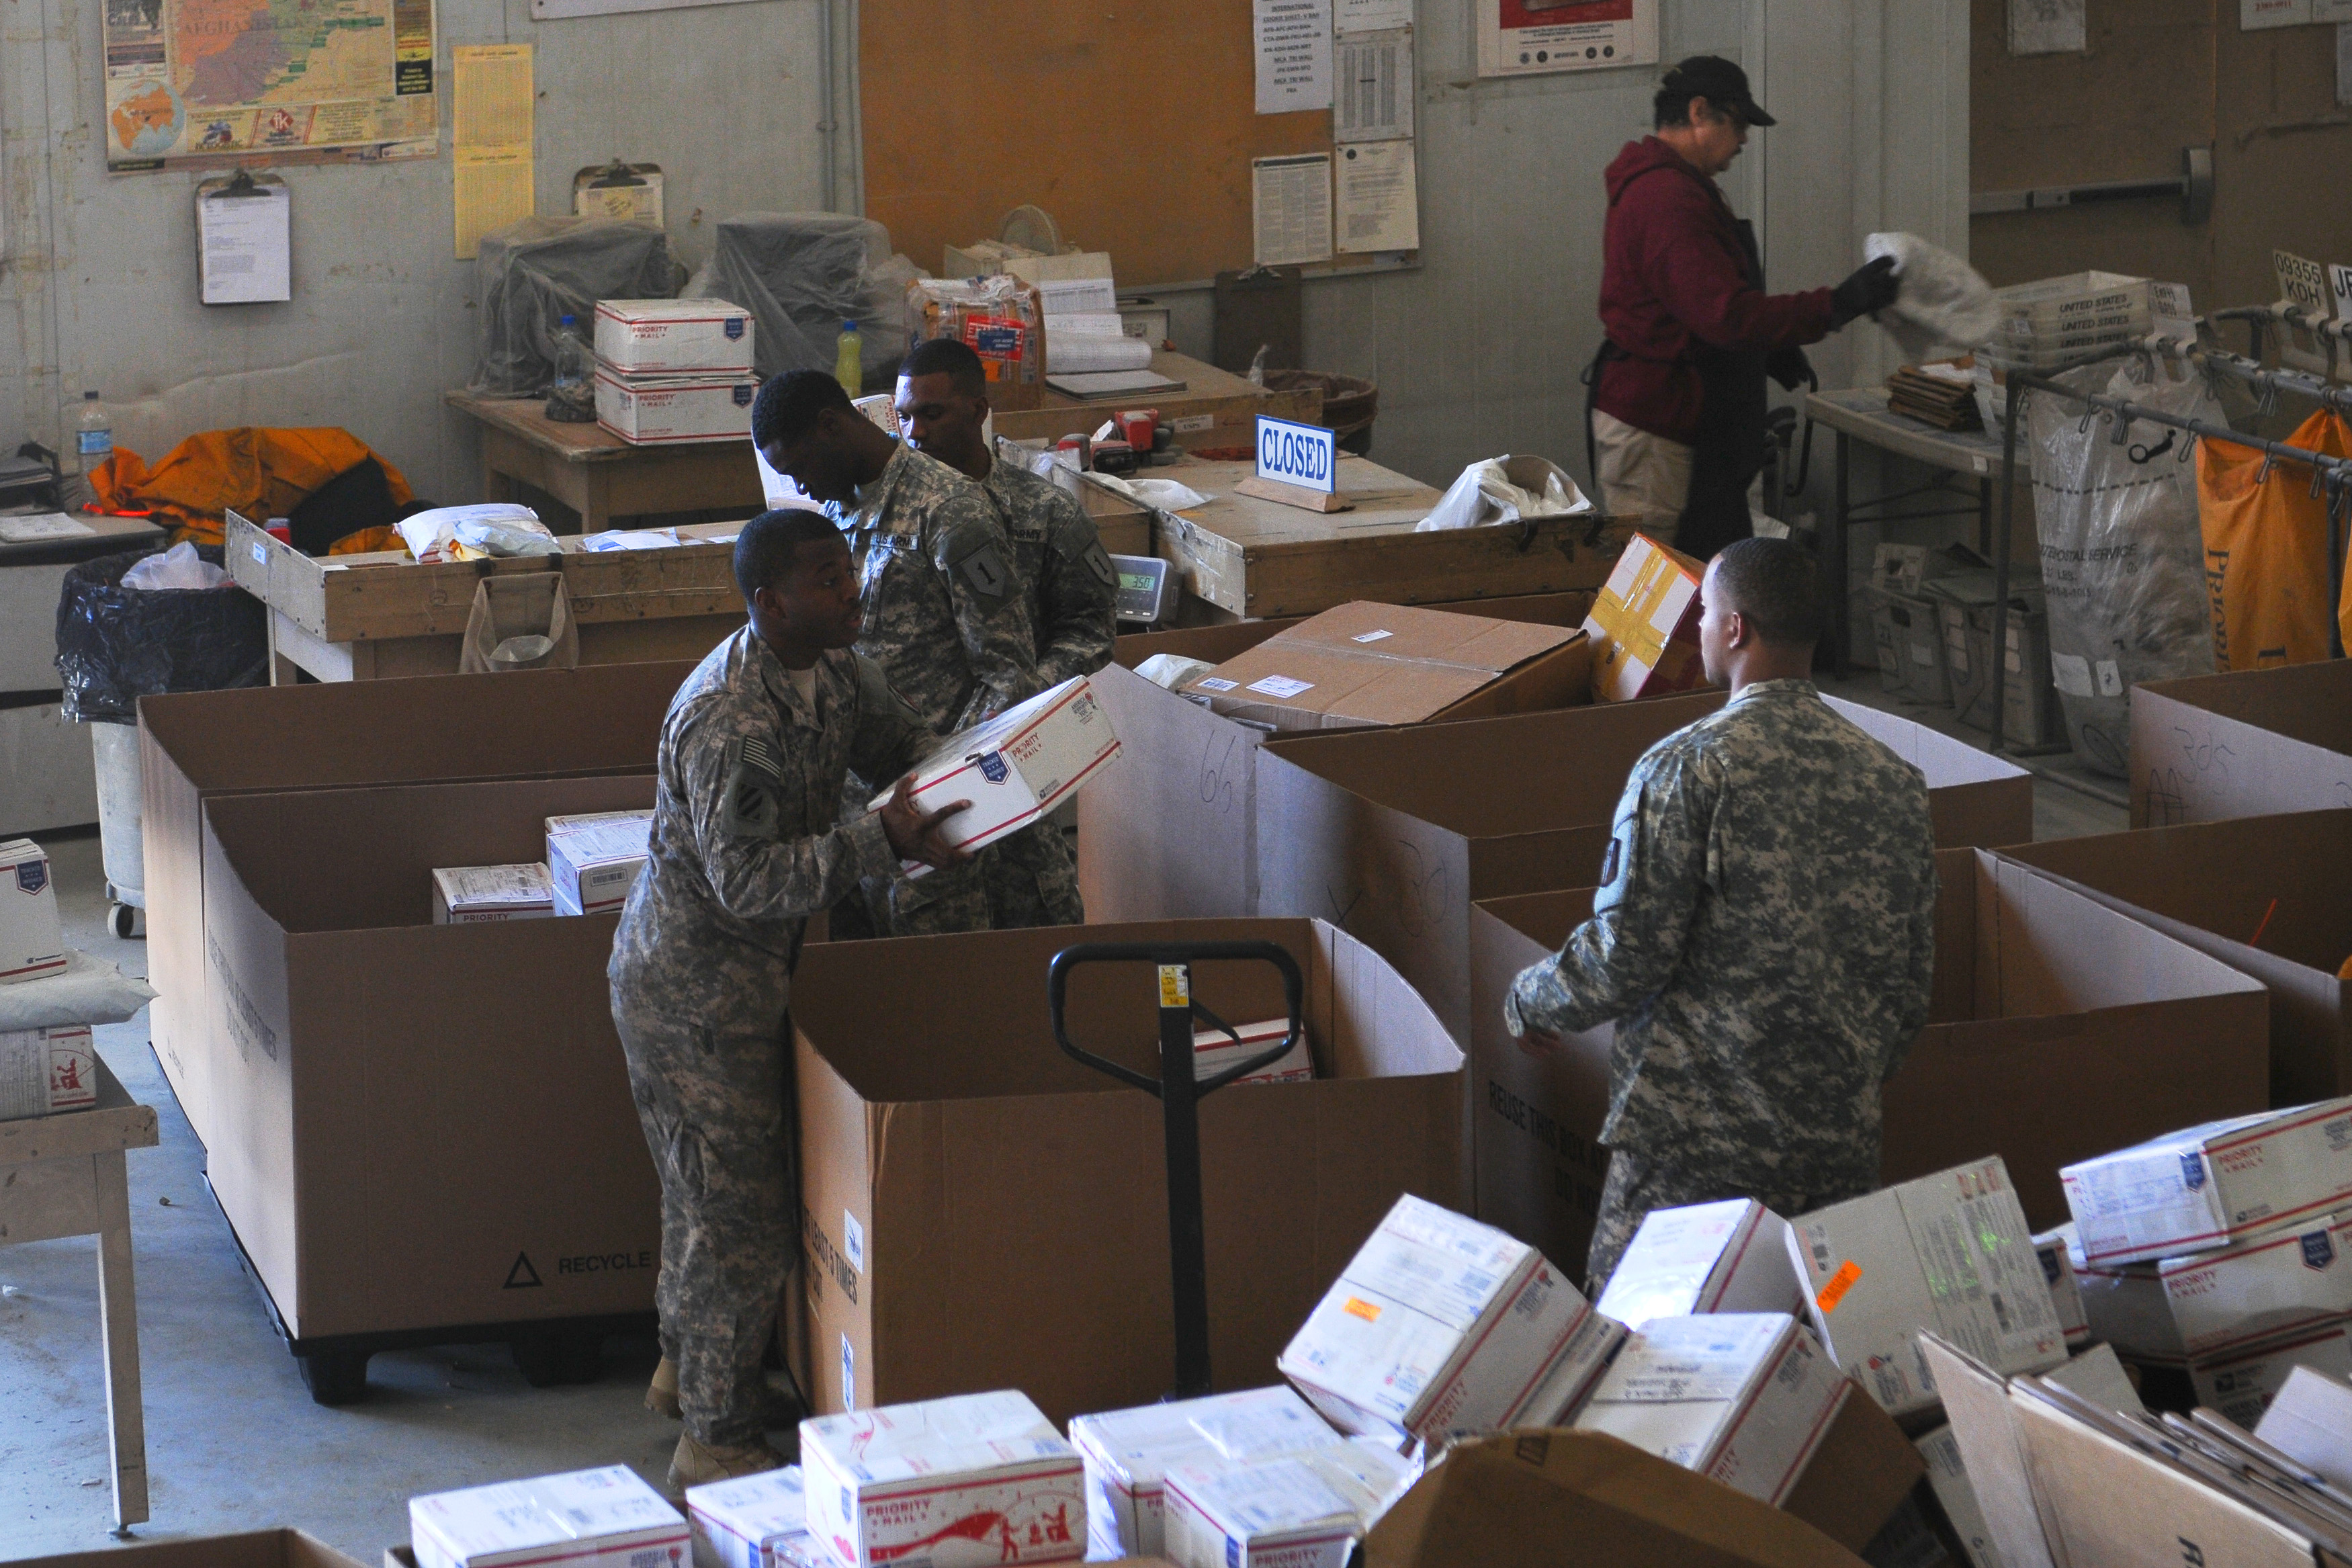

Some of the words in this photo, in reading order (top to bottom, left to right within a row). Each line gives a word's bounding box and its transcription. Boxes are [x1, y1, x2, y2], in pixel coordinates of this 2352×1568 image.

[2275, 253, 2321, 284] 09355
[2285, 277, 2321, 307] KDH
[2060, 300, 2093, 312] UNITED
[2095, 294, 2127, 306] STATES
[2062, 319, 2095, 331] UNITED
[2097, 314, 2129, 327] STATES
[887, 402, 898, 432] PRIORI
[1263, 427, 1327, 480] CLOSED
[2089, 543, 2137, 560] SERVICE
[1012, 732, 1039, 757] PRIORITY
[1022, 746, 1039, 760] MAIL
[464, 913, 509, 922] PRIORITY
[1489, 1080, 1526, 1131] REUSE
[1528, 1106, 1556, 1151] THIS
[2218, 1145, 2263, 1166] PRIORITY
[559, 1252, 651, 1274] RECYCLE
[811, 1217, 828, 1269] LEAST
[835, 1250, 857, 1306] TIMES
[867, 1498, 932, 1517] PRIORITY
[882, 1513, 916, 1525] MAIL
[1255, 1549, 1322, 1567] PRIORITY
